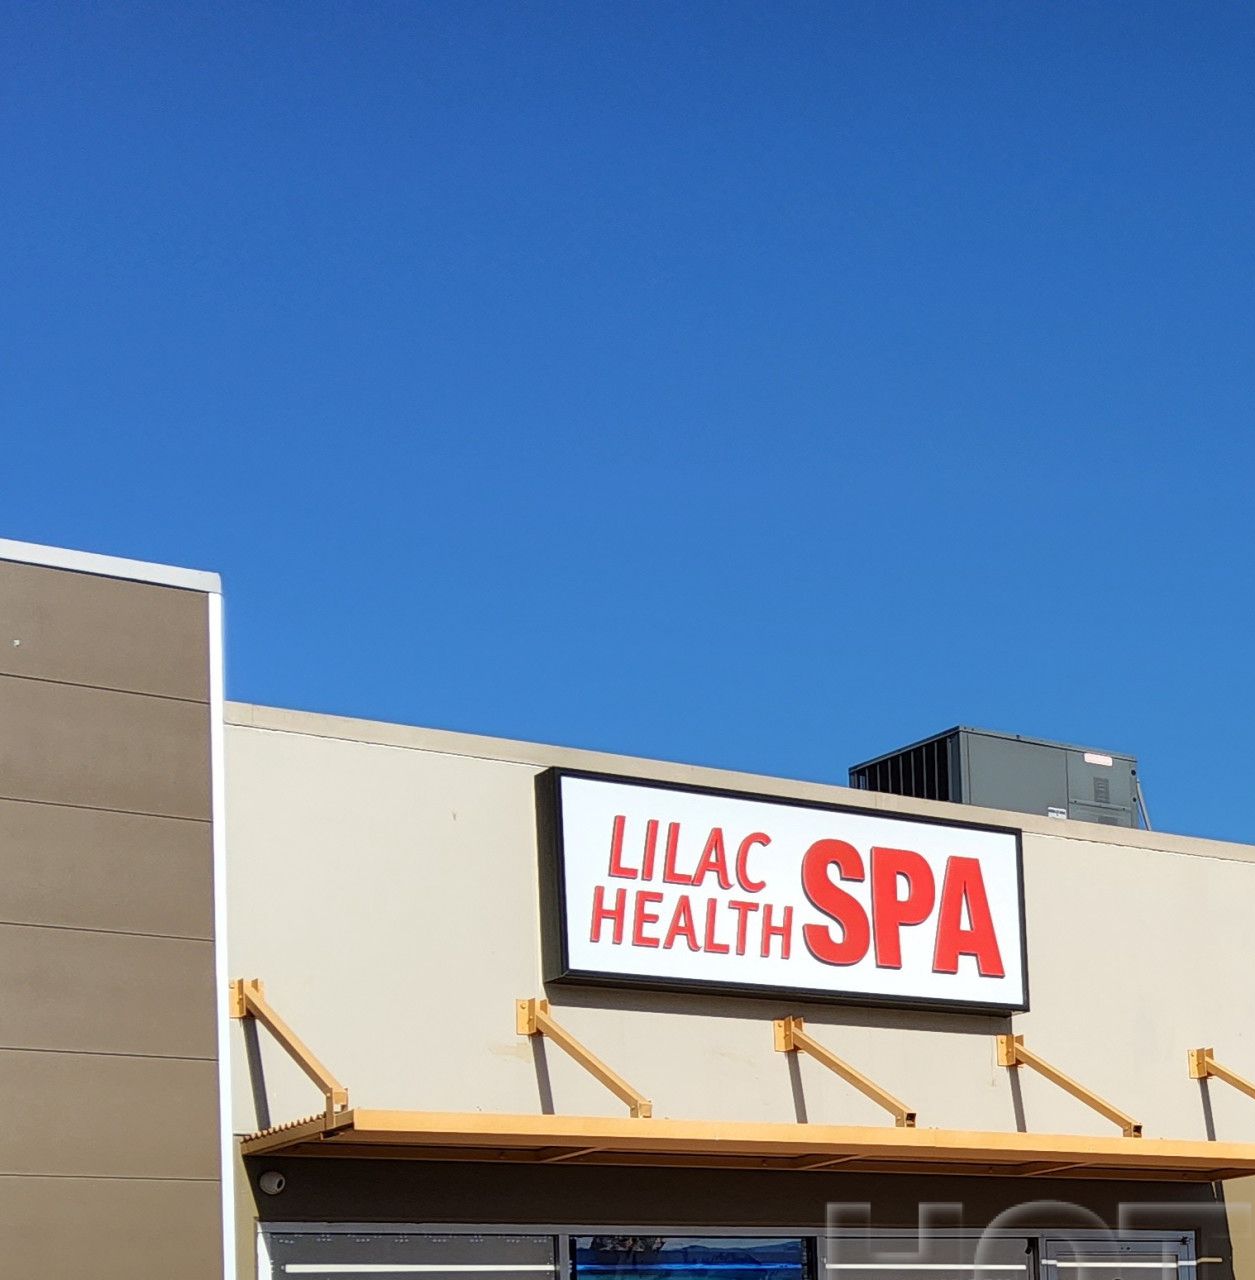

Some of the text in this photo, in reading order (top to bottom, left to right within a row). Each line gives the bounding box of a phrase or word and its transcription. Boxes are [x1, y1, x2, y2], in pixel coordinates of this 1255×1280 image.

[608, 815, 771, 892] LILAC
[590, 885, 793, 959] HEALTH
[802, 838, 1005, 978] SPA
